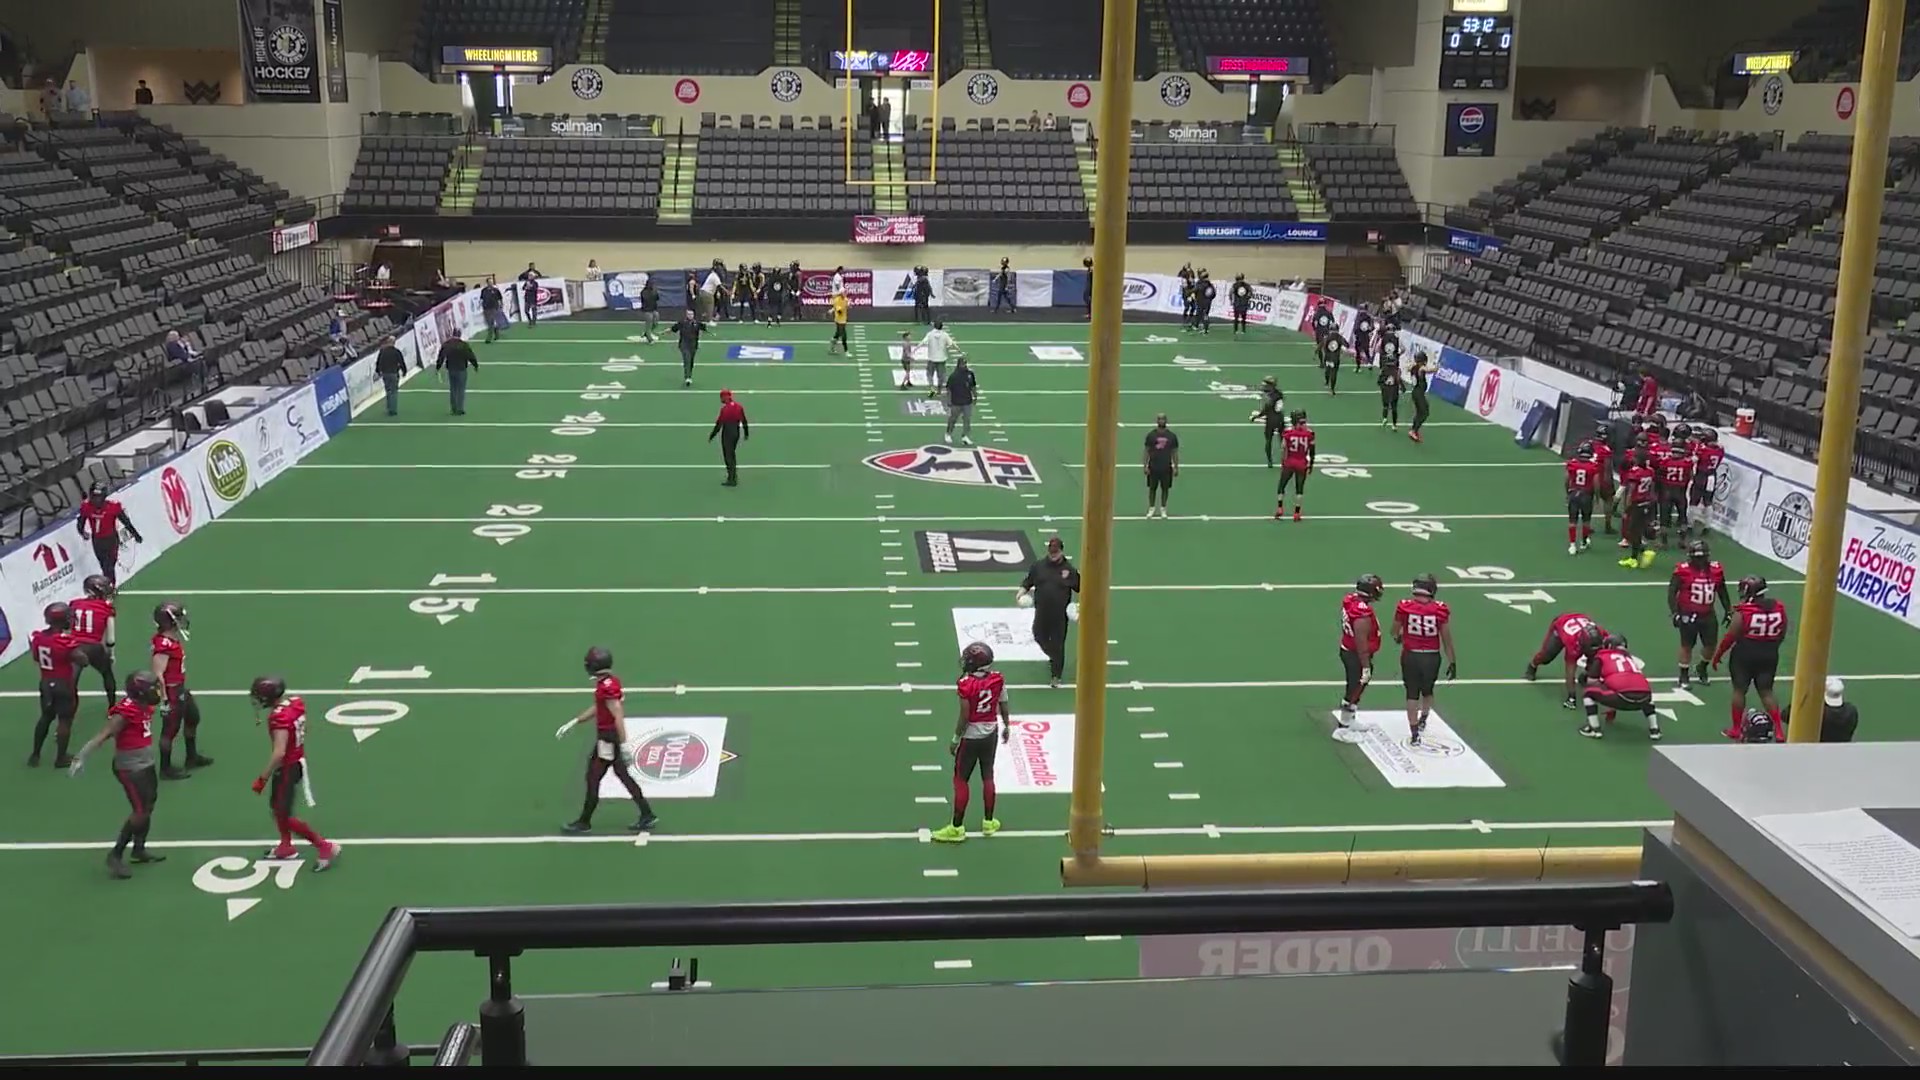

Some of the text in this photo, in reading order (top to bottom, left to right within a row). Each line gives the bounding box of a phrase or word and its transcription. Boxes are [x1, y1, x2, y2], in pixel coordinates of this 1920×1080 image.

[1462, 18, 1494, 33] 53:12
[1450, 33, 1460, 48] 0
[1501, 33, 1510, 48] 0
[254, 66, 310, 79] HOCKEY
[551, 119, 602, 134] spilman
[1168, 126, 1217, 141] spilman
[1198, 228, 1216, 236] BUD
[1218, 228, 1241, 236] LIGHT
[1287, 229, 1318, 237] LOUNGE
[1290, 436, 1309, 452] 34
[1575, 469, 1587, 486] 8
[1666, 467, 1684, 482] 21
[472, 504, 543, 537] 20
[1763, 507, 1780, 531] BIG
[1782, 514, 1813, 541] TIMBE
[925, 531, 958, 573] RUSSELL
[1867, 526, 1917, 563] Zambito
[1845, 537, 1916, 594] Flooring
[409, 573, 498, 614] 15
[1446, 565, 1556, 604] 15
[1836, 564, 1912, 618] AMERICA
[75, 609, 95, 633] 11
[1407, 613, 1437, 637] 88
[1748, 612, 1783, 637] 52
[38, 646, 54, 671] 6
[325, 665, 433, 726] 10
[976, 689, 993, 713] 2
[659, 735, 691, 779] VOCELLI
[1022, 732, 1058, 787] Panhandle
[192, 856, 306, 894] 5
